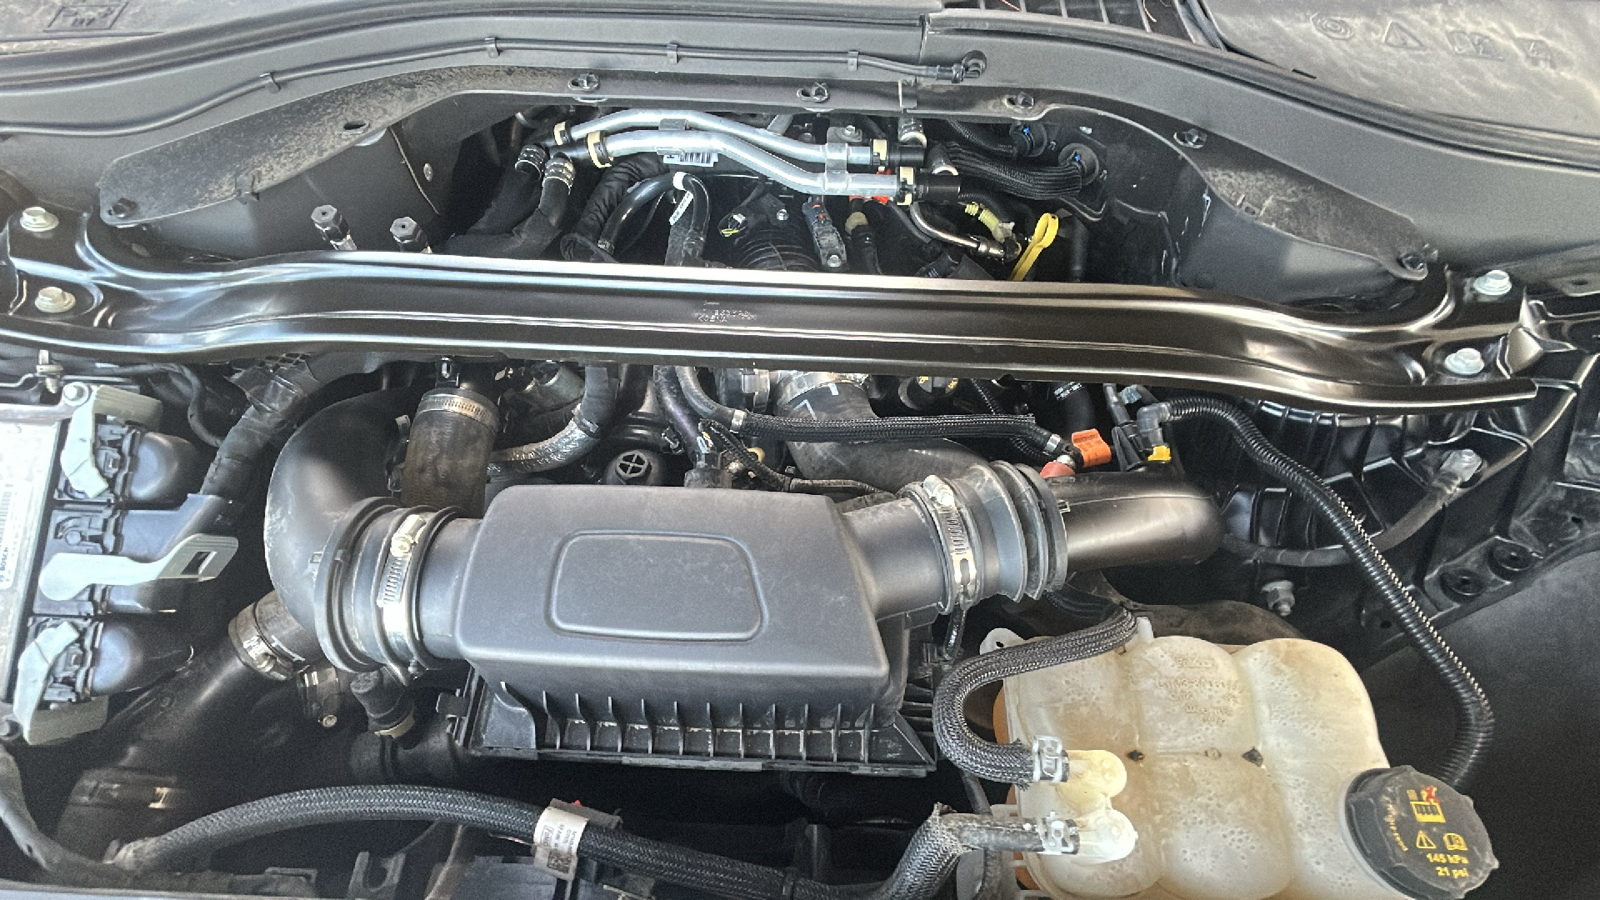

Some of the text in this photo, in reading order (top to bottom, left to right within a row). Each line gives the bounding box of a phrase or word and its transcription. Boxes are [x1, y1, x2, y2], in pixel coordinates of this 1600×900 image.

[0, 547, 9, 571] BOSCH
[1426, 852, 1469, 864] 145 kPa
[1435, 866, 1469, 879] 21 psi
